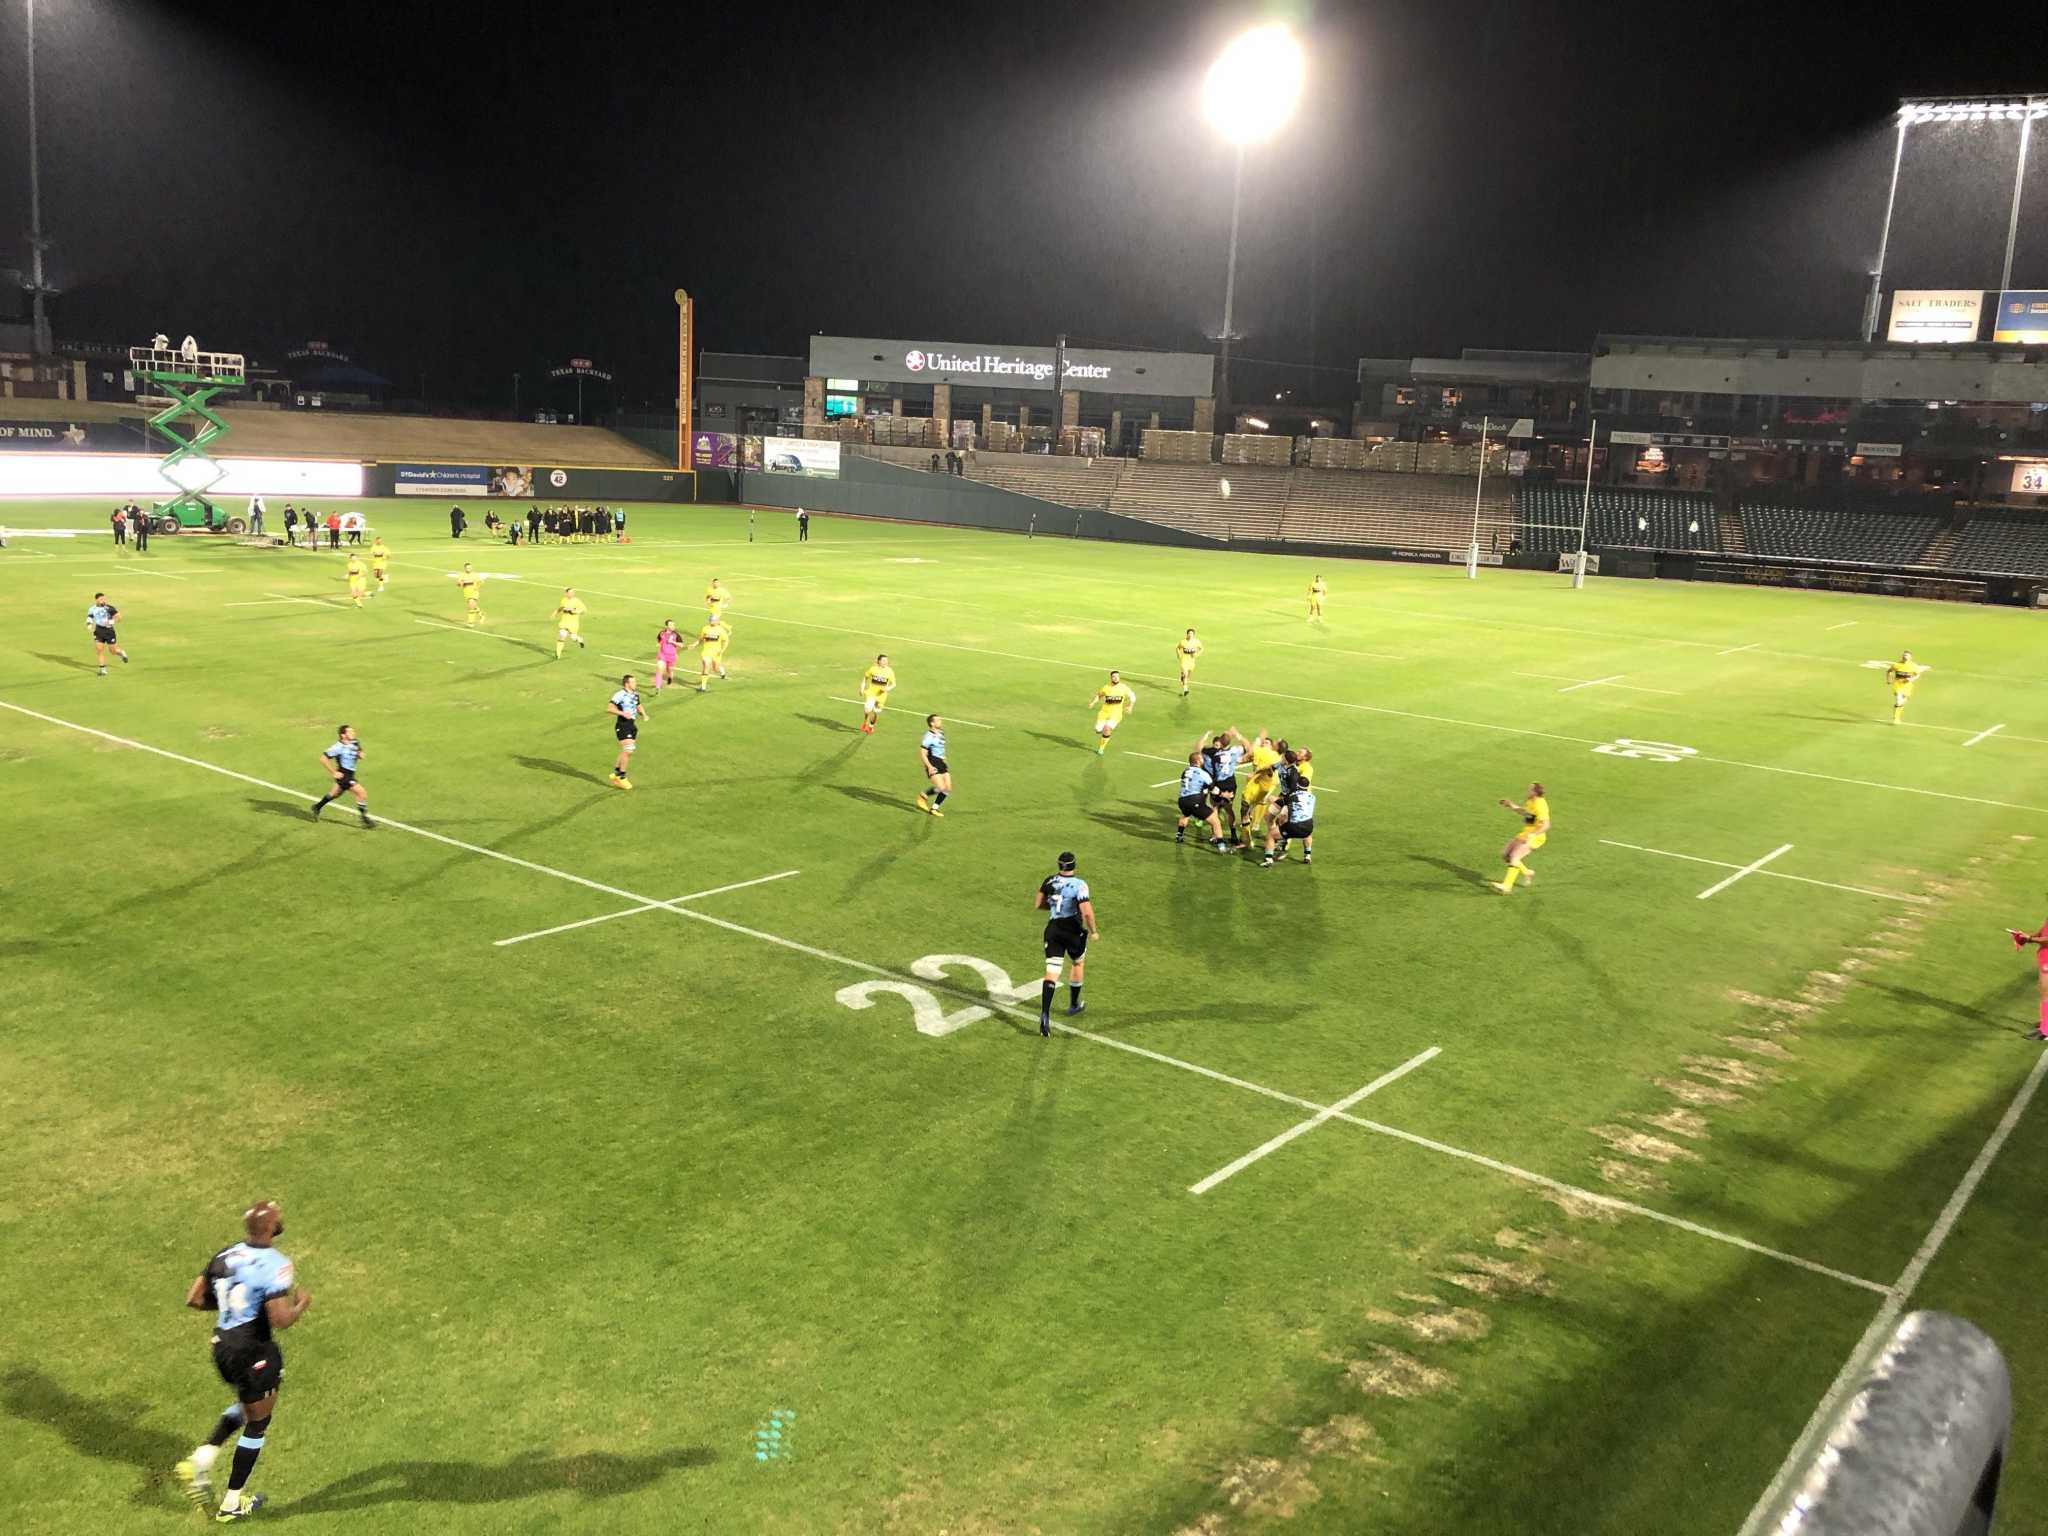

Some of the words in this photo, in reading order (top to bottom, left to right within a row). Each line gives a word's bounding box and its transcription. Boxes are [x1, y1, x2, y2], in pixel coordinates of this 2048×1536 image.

[927, 353, 981, 372] United
[983, 356, 1053, 380] Heritage
[1062, 360, 1111, 378] Center
[18, 427, 55, 438] MIND.
[553, 475, 564, 484] 42
[2022, 475, 2043, 490] 34
[1589, 738, 1699, 762] 50
[834, 953, 1064, 1037] 22
